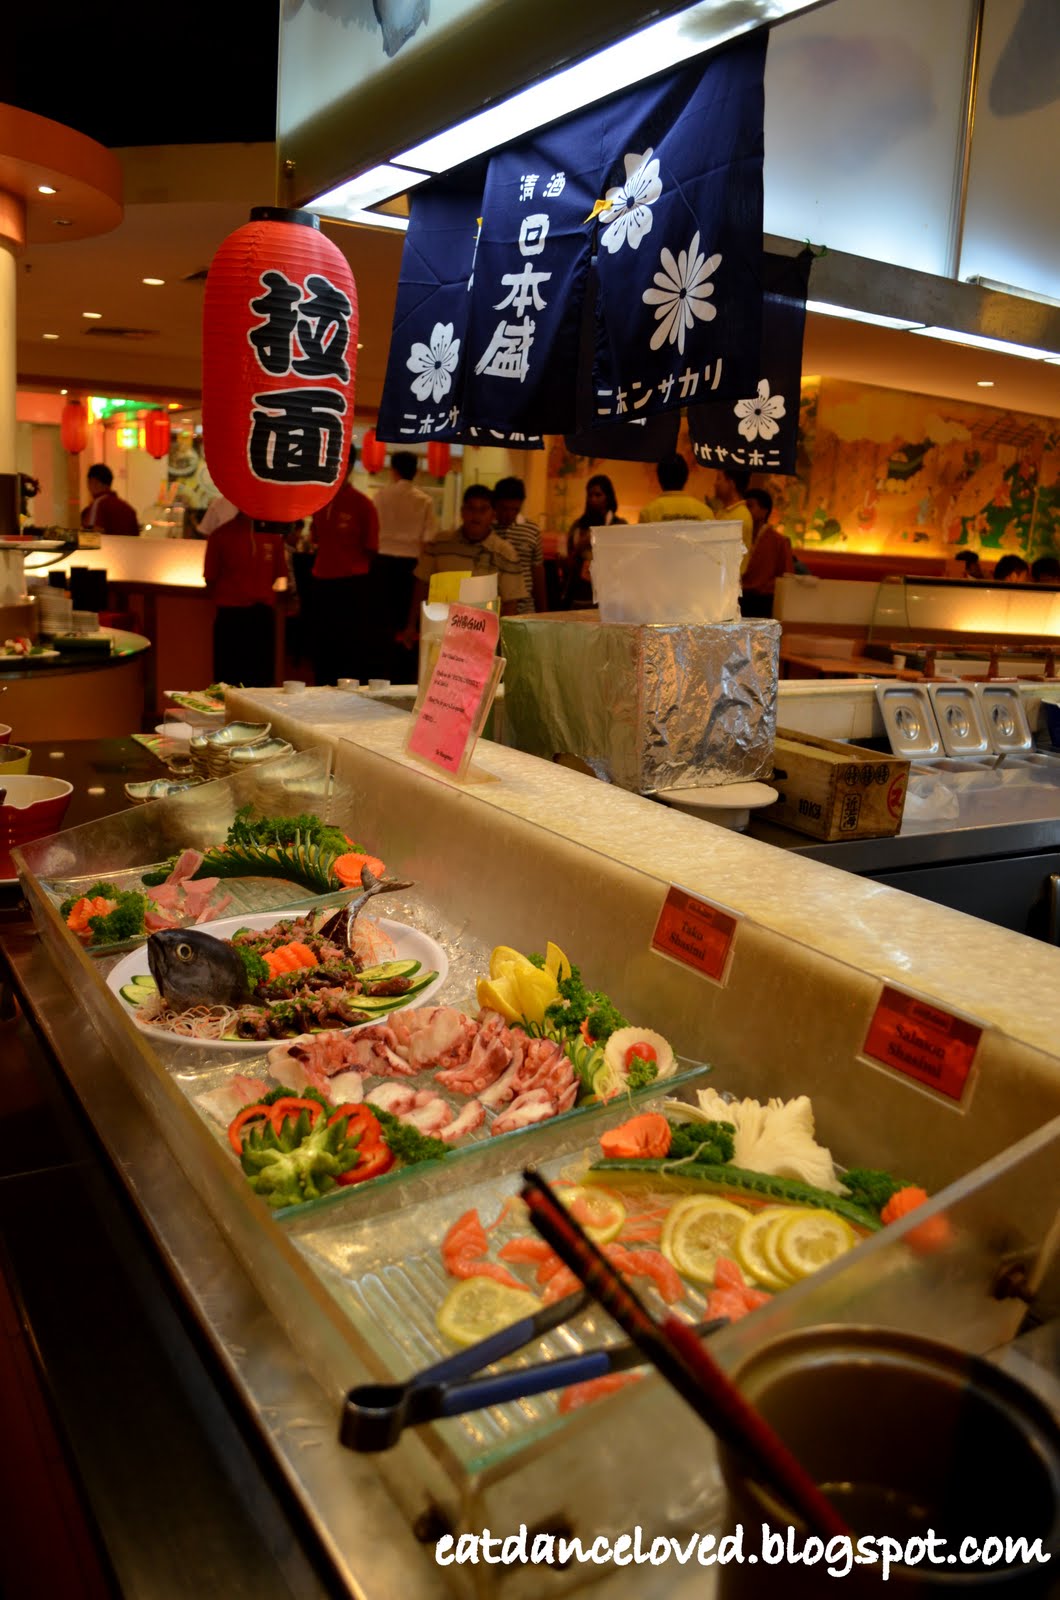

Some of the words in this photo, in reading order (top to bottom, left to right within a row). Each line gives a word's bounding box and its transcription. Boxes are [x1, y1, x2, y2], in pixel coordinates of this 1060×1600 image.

[519, 171, 566, 201] 清酒
[475, 213, 552, 384] 日本盛
[247, 270, 352, 486] 拉面
[596, 357, 723, 416] ニホンサカリ
[450, 613, 486, 634] SHOGUN
[895, 1023, 945, 1060] Salmon
